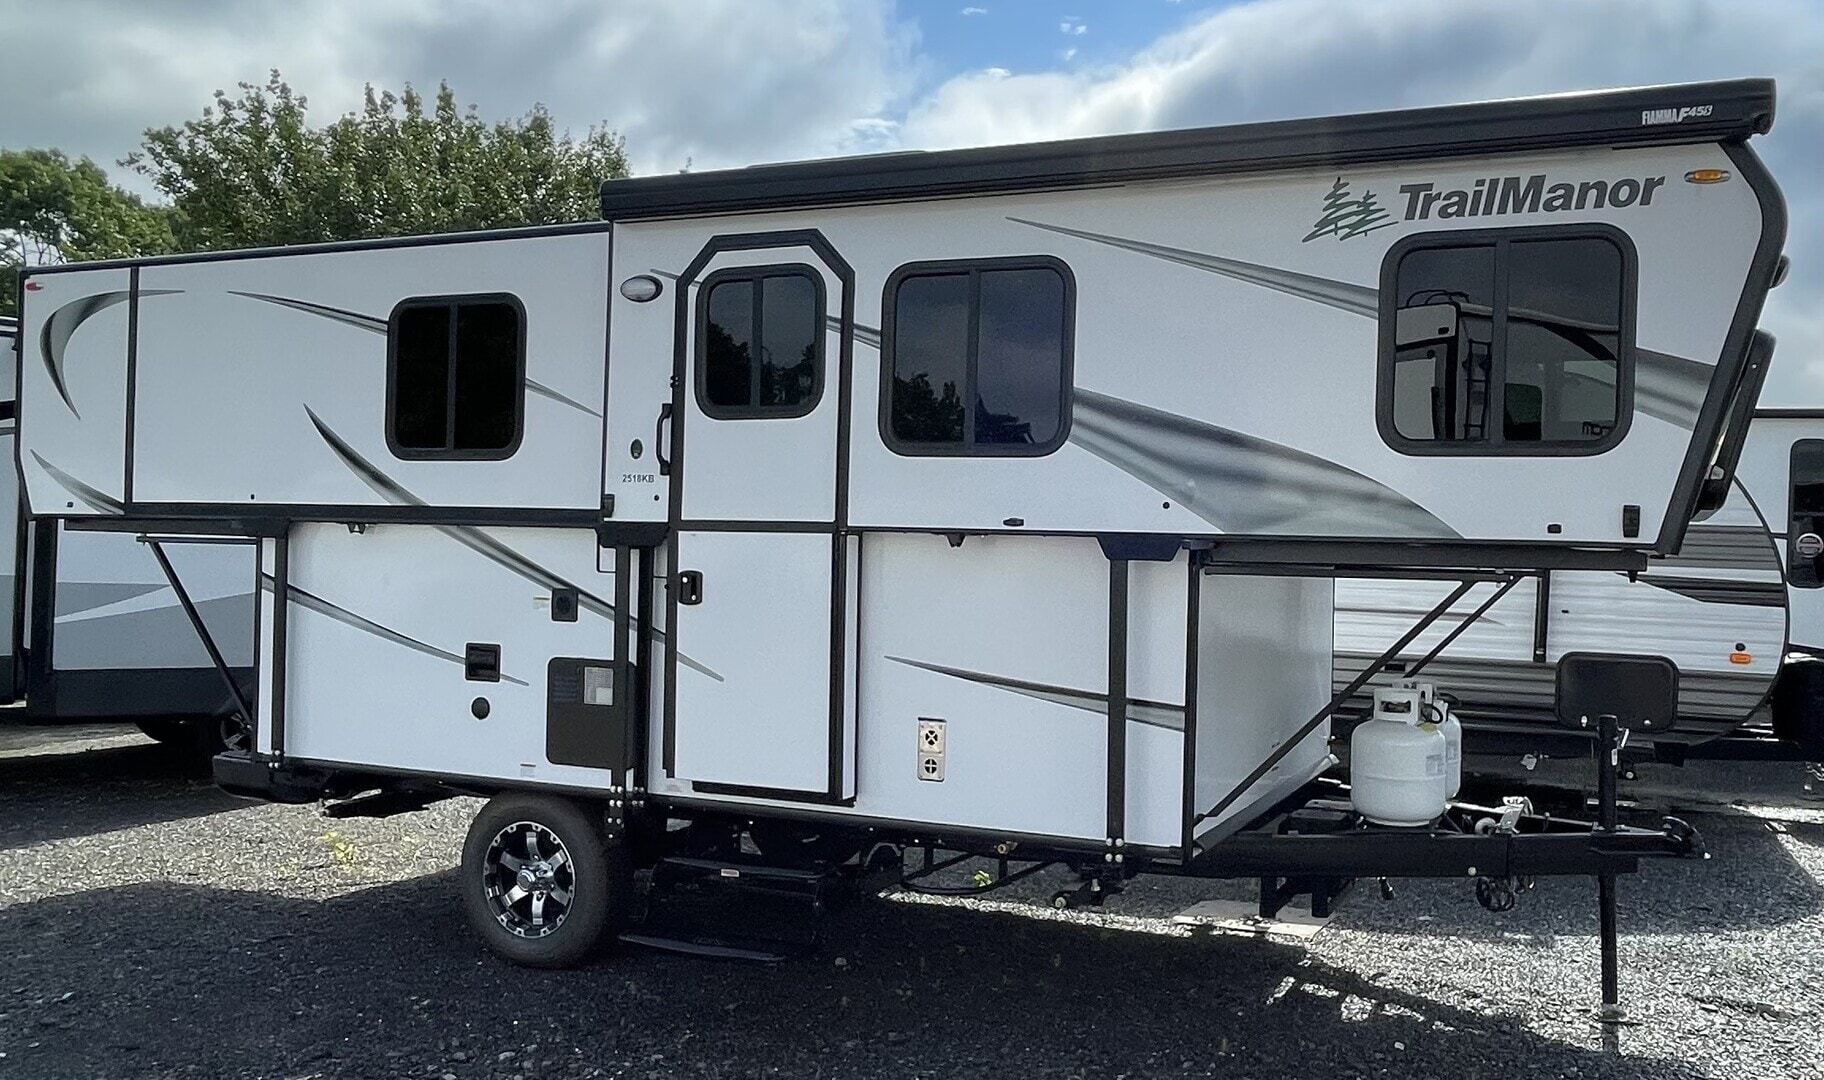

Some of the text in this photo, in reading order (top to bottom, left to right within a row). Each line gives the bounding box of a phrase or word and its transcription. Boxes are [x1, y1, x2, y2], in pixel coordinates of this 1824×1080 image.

[1642, 108, 1678, 125] FIAMMA
[1399, 174, 1666, 220] TrailManor
[622, 474, 655, 483] 2518KB
